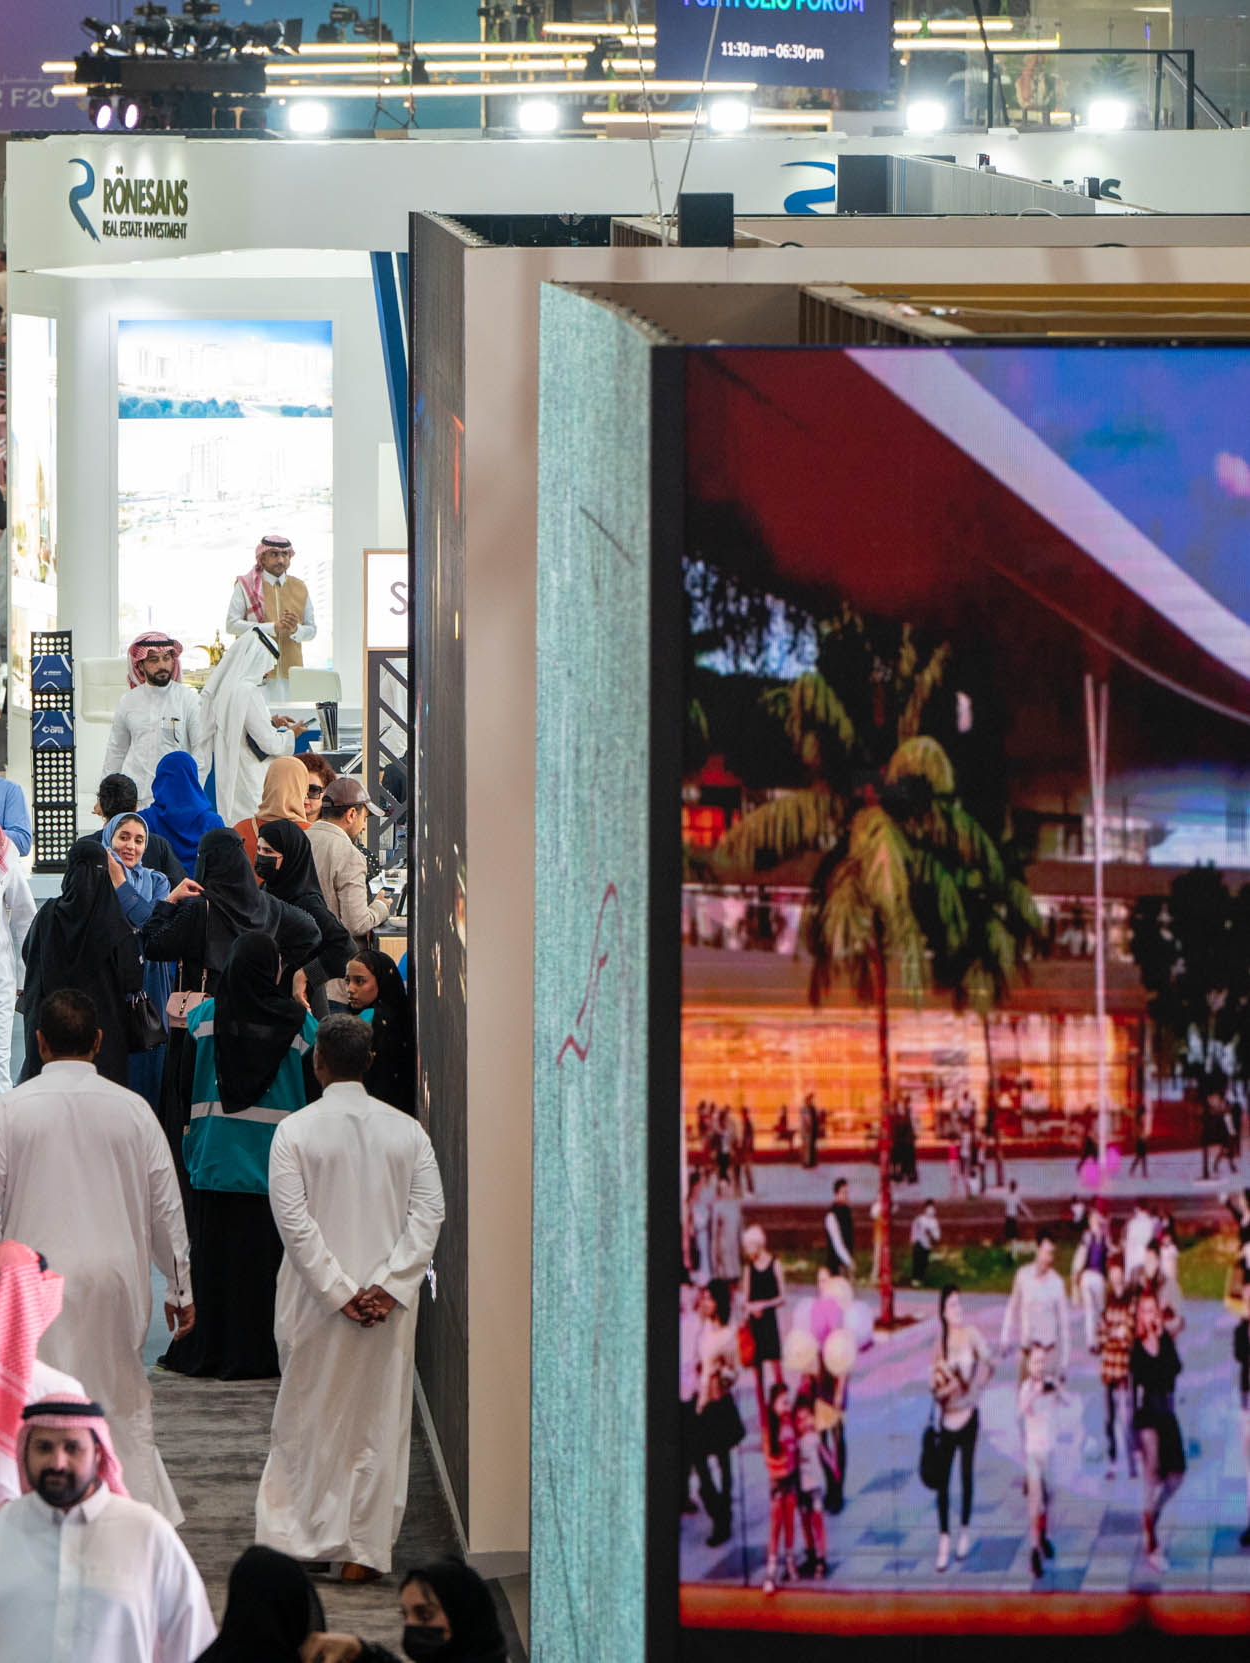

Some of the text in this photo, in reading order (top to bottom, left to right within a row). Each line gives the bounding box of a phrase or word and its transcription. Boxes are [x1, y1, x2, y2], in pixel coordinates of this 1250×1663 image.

[11, 88, 60, 108] F20
[103, 166, 188, 216] RÖNESANS
[103, 220, 188, 239] REAL ESTATE INVESTMENT
